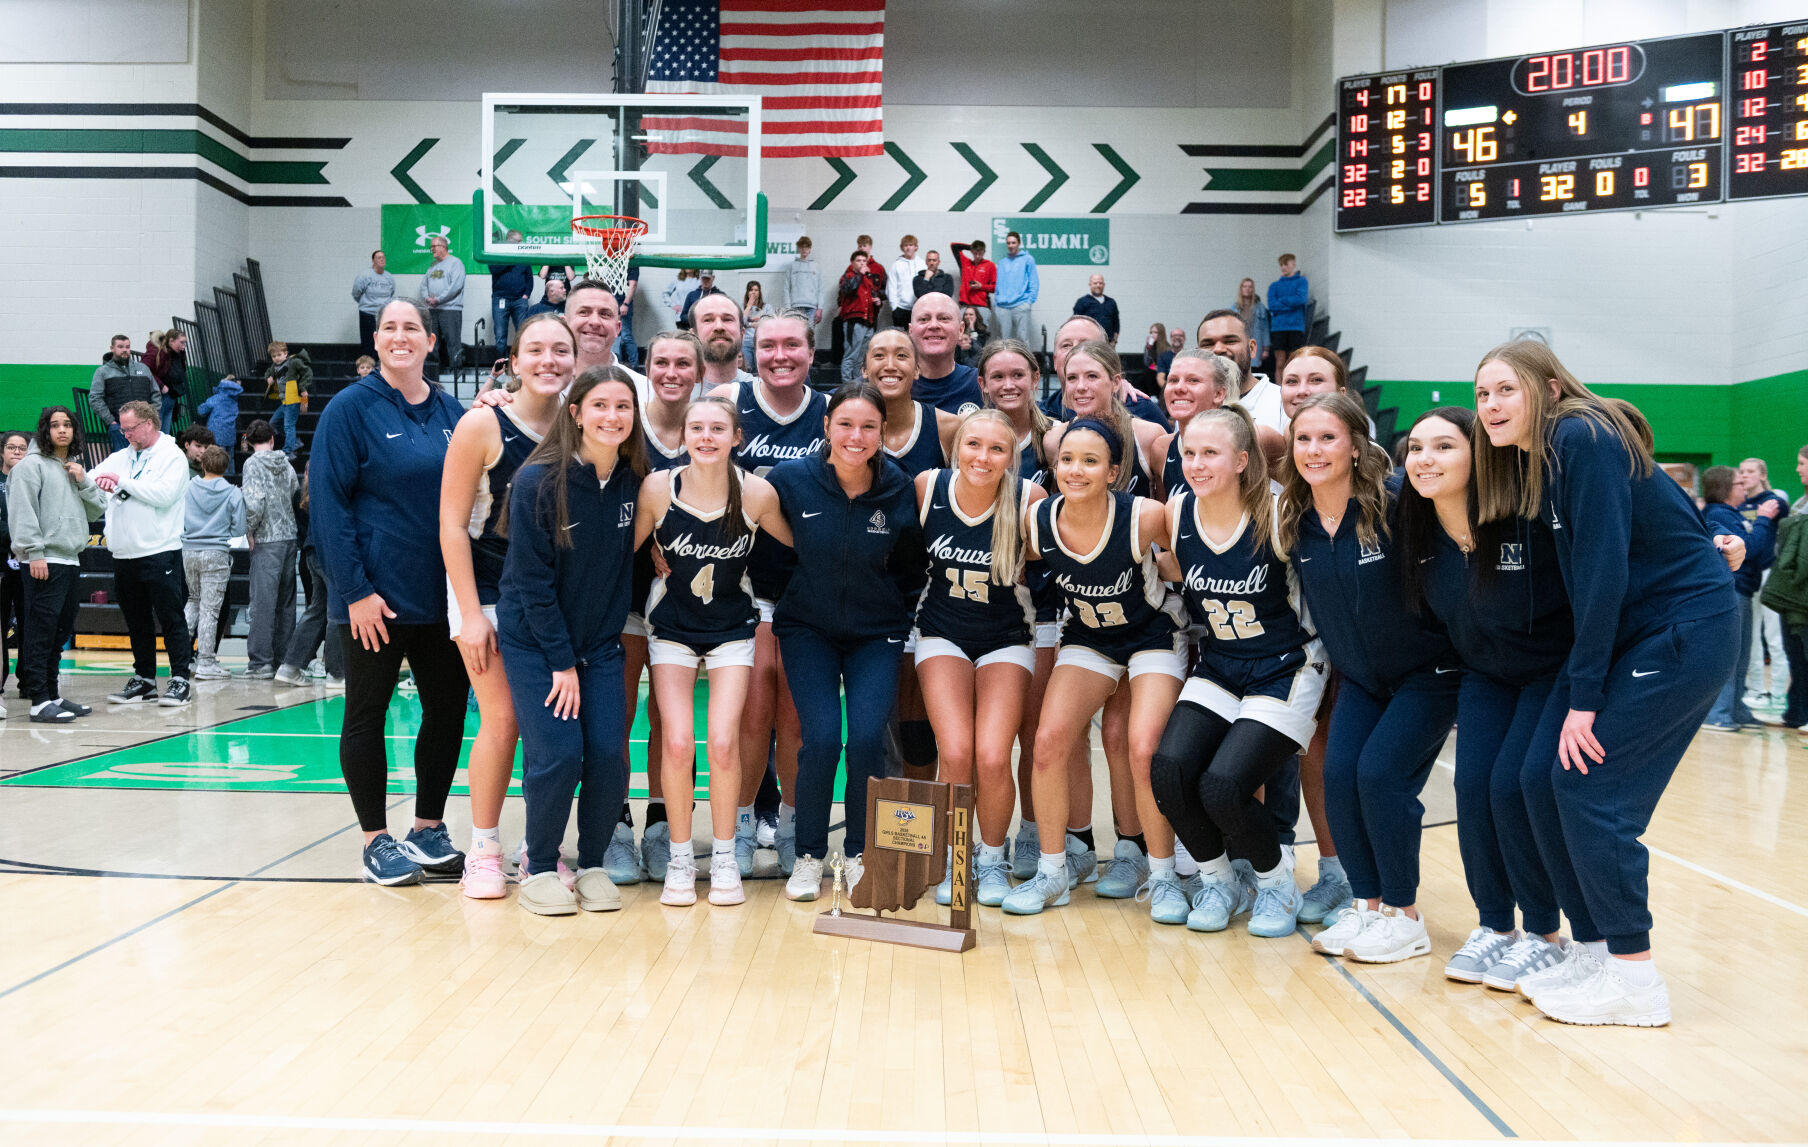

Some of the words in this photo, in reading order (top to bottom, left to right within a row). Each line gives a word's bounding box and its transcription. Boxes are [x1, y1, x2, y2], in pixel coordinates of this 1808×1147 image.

[1735, 29, 1770, 42] PLAYER
[1751, 41, 1768, 62] 2
[1527, 46, 1630, 92] 20:00
[1744, 69, 1768, 91] 10
[1356, 89, 1369, 108] 4
[1387, 84, 1407, 105] 17
[1418, 82, 1431, 101] 0
[1743, 97, 1767, 118] 12
[1350, 114, 1368, 133] 10
[1386, 110, 1406, 129] 12
[1424, 107, 1431, 126] 1
[1568, 111, 1587, 135] 4
[1669, 102, 1721, 141] 47
[1349, 139, 1368, 158] 14
[1391, 135, 1405, 154] 5
[1418, 133, 1431, 151] 3
[1453, 127, 1498, 162] 46
[1736, 124, 1767, 146] 24
[1539, 161, 1577, 174] PLAYER
[1589, 157, 1622, 170] FOULS
[1672, 149, 1706, 162] FOULS
[1735, 152, 1767, 174] 32
[1343, 164, 1367, 183] 32
[1391, 160, 1405, 179] 2
[1417, 158, 1430, 176] 0
[1455, 170, 1486, 182] FOULS
[1634, 167, 1649, 187] 0
[1687, 162, 1708, 188] 3
[1343, 189, 1367, 208] 22
[1391, 185, 1405, 204] 5
[1416, 183, 1430, 202] 2
[1469, 182, 1487, 207] 5
[1512, 178, 1520, 198] 1
[1540, 174, 1575, 201] 32
[1595, 171, 1615, 196] 0
[526, 235, 561, 244] SOUTH
[737, 433, 826, 460] Norwell
[664, 532, 749, 560] Norwell
[926, 533, 992, 566] Norwe
[1500, 543, 1523, 565] N
[690, 563, 715, 605] 4
[945, 567, 990, 604] 15
[1055, 567, 1133, 597] Norwell
[1185, 563, 1269, 595] Norwell
[1201, 597, 1266, 641] 22
